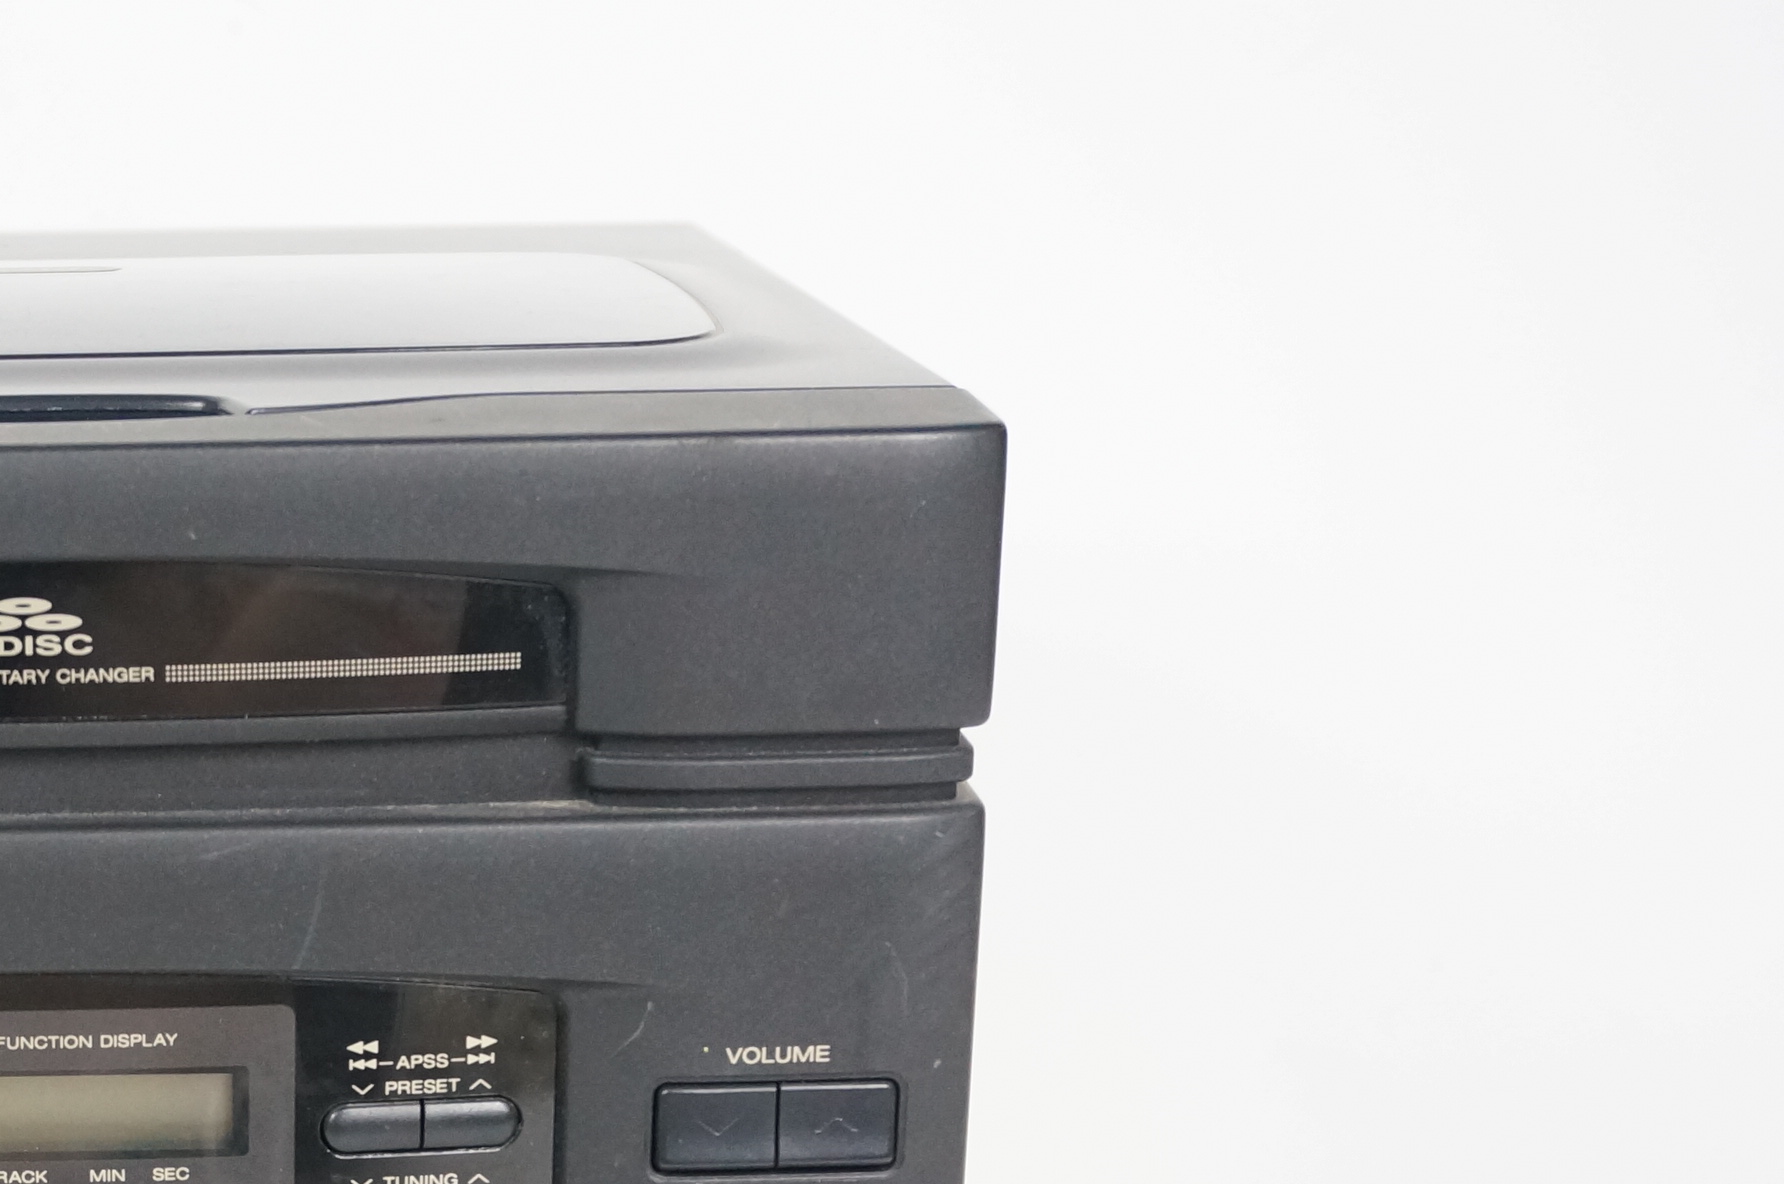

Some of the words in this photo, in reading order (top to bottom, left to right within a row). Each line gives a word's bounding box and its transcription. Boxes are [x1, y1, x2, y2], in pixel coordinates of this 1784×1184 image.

[56, 667, 154, 684] CHANGER
[101, 1033, 177, 1048] DISPLAY
[396, 1053, 448, 1069] APSS
[726, 1045, 830, 1064] VOLUME
[385, 1078, 460, 1095] PRESET
[90, 1169, 125, 1182] MIN
[153, 1167, 189, 1181] SEC
